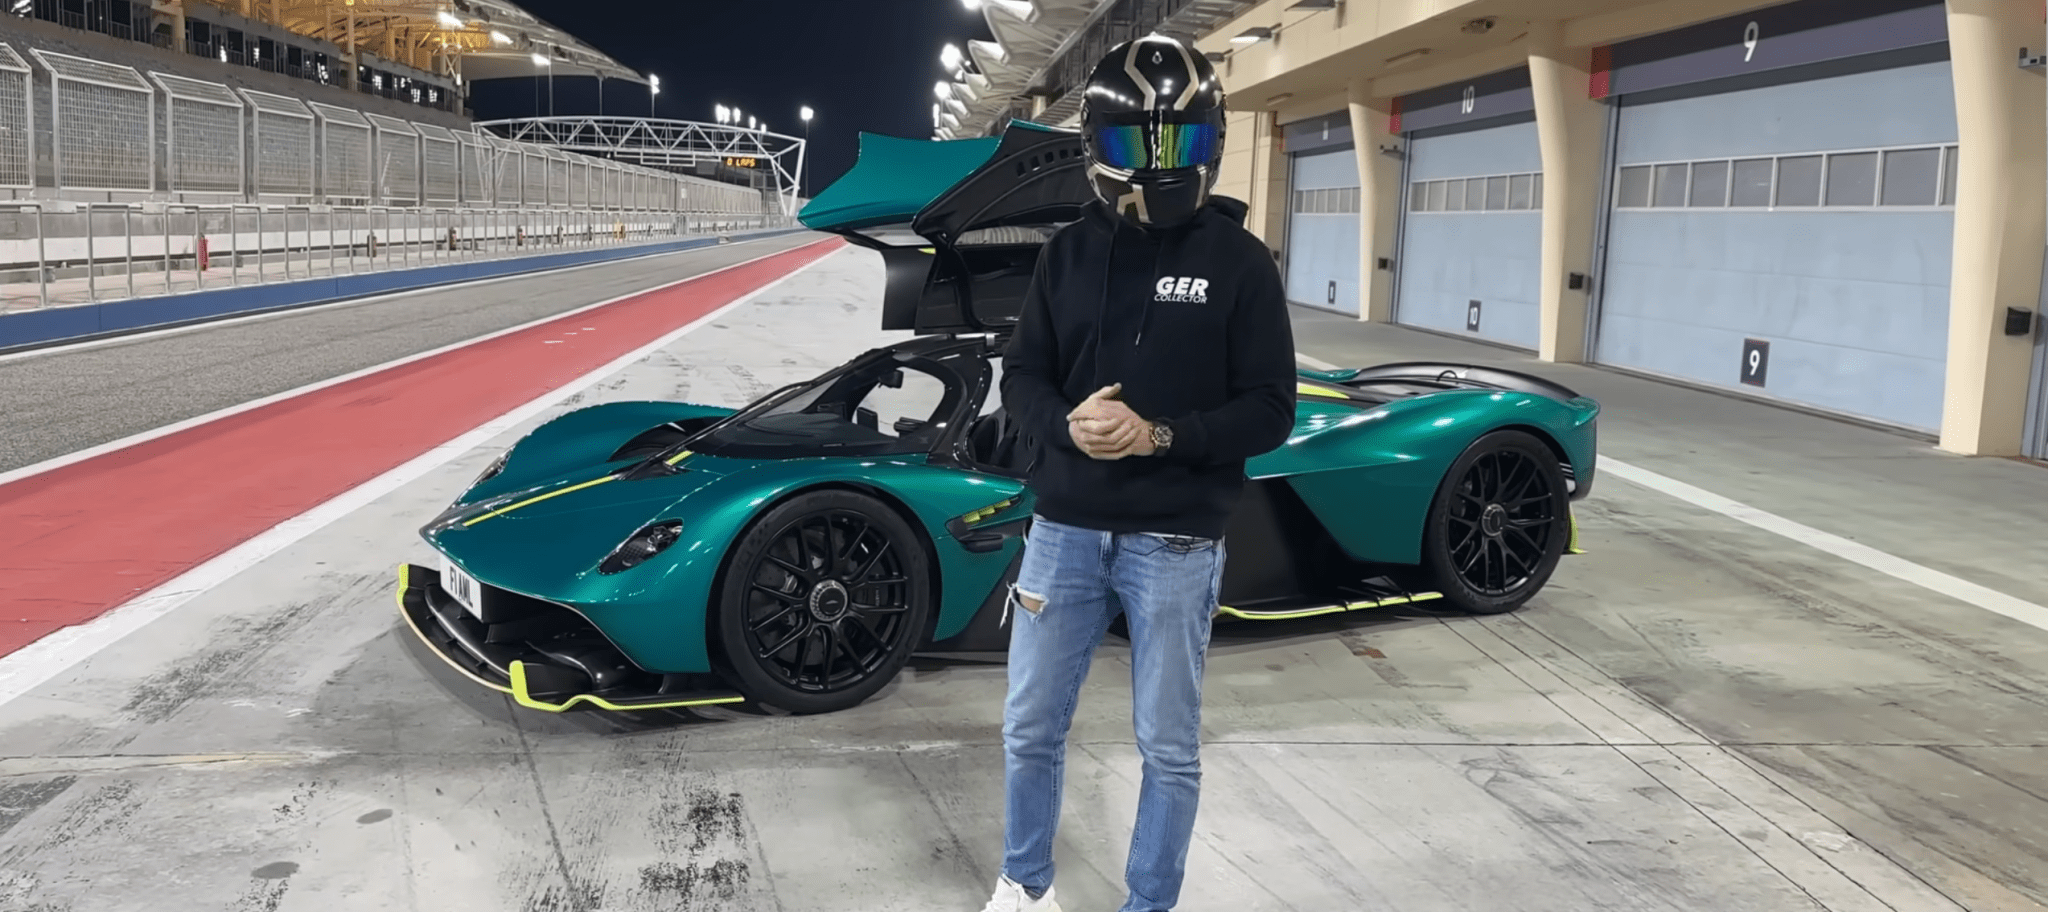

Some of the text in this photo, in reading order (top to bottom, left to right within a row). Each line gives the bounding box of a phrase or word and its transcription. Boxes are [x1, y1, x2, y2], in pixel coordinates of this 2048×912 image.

[1744, 21, 1760, 62] 9
[1461, 85, 1475, 114] 10
[1155, 276, 1209, 296] GER
[1154, 293, 1208, 304] COLLECTOR
[1469, 307, 1478, 325] 10
[1749, 350, 1761, 376] 9
